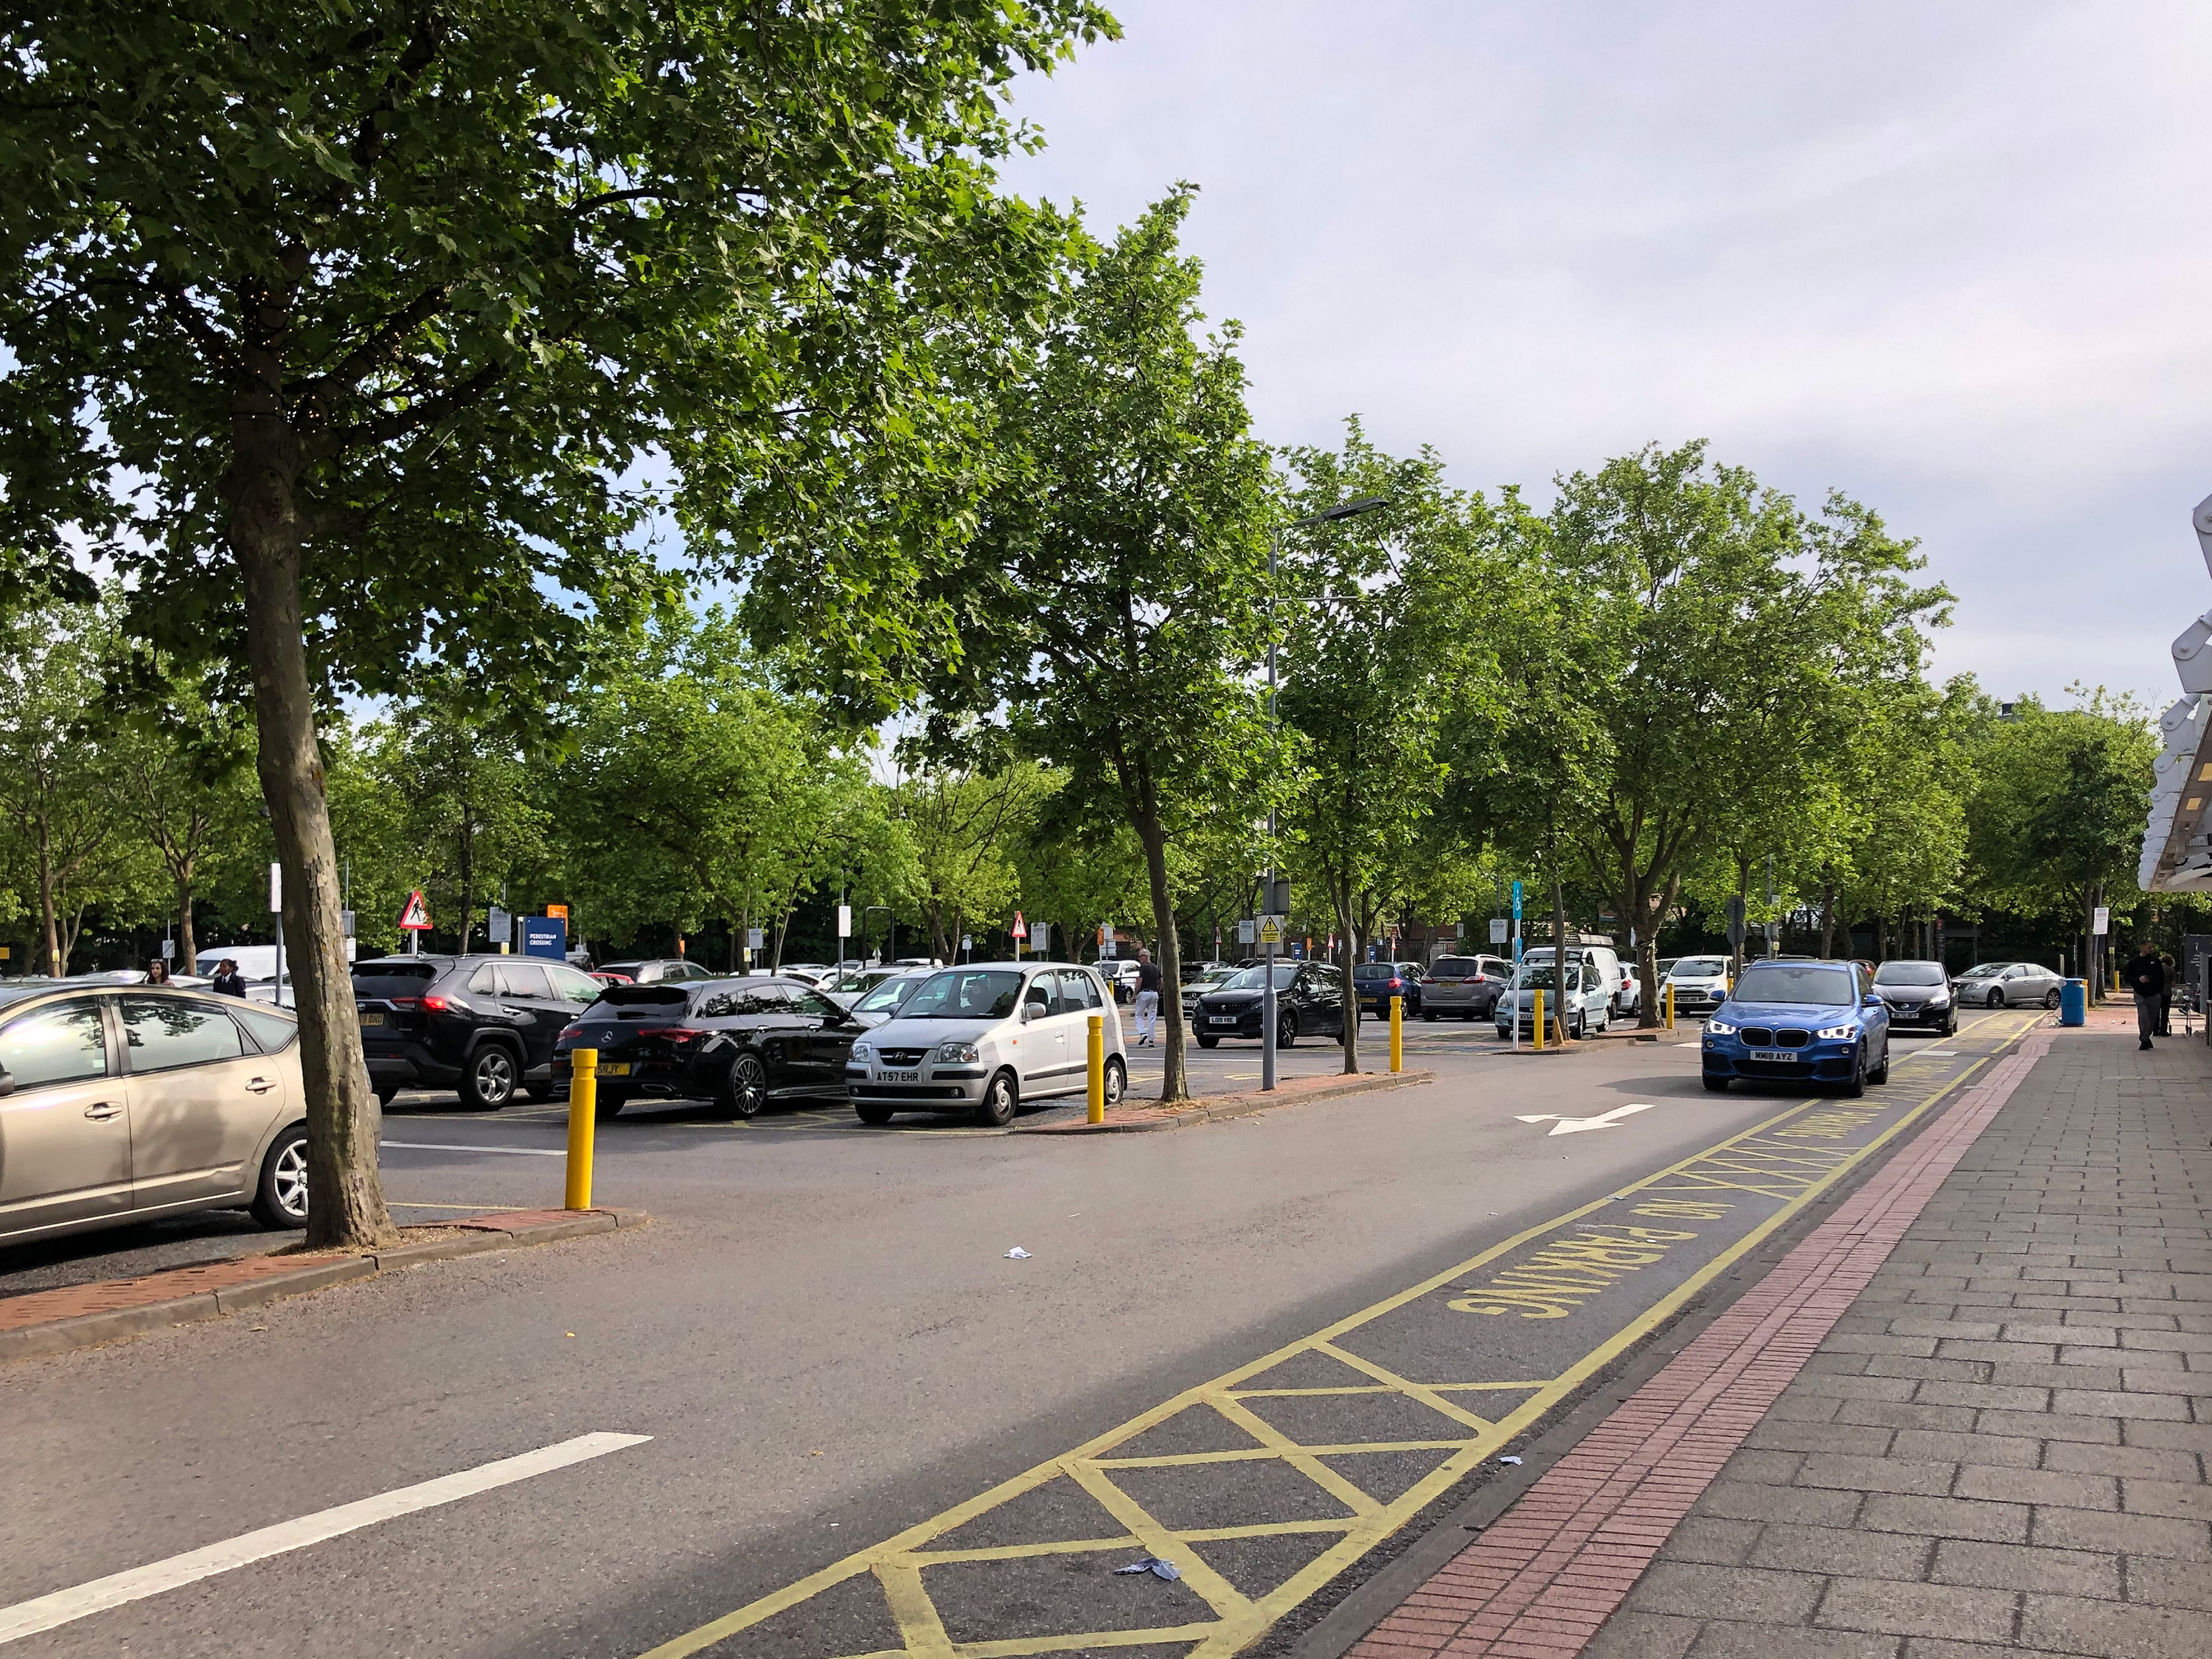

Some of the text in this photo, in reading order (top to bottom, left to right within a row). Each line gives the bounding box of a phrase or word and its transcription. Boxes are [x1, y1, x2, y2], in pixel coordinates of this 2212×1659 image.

[1755, 1051, 1792, 1061] MM18 AYZ
[877, 1071, 919, 1082] AT57 EHR
[1447, 1198, 1736, 1319] NO PARKING
